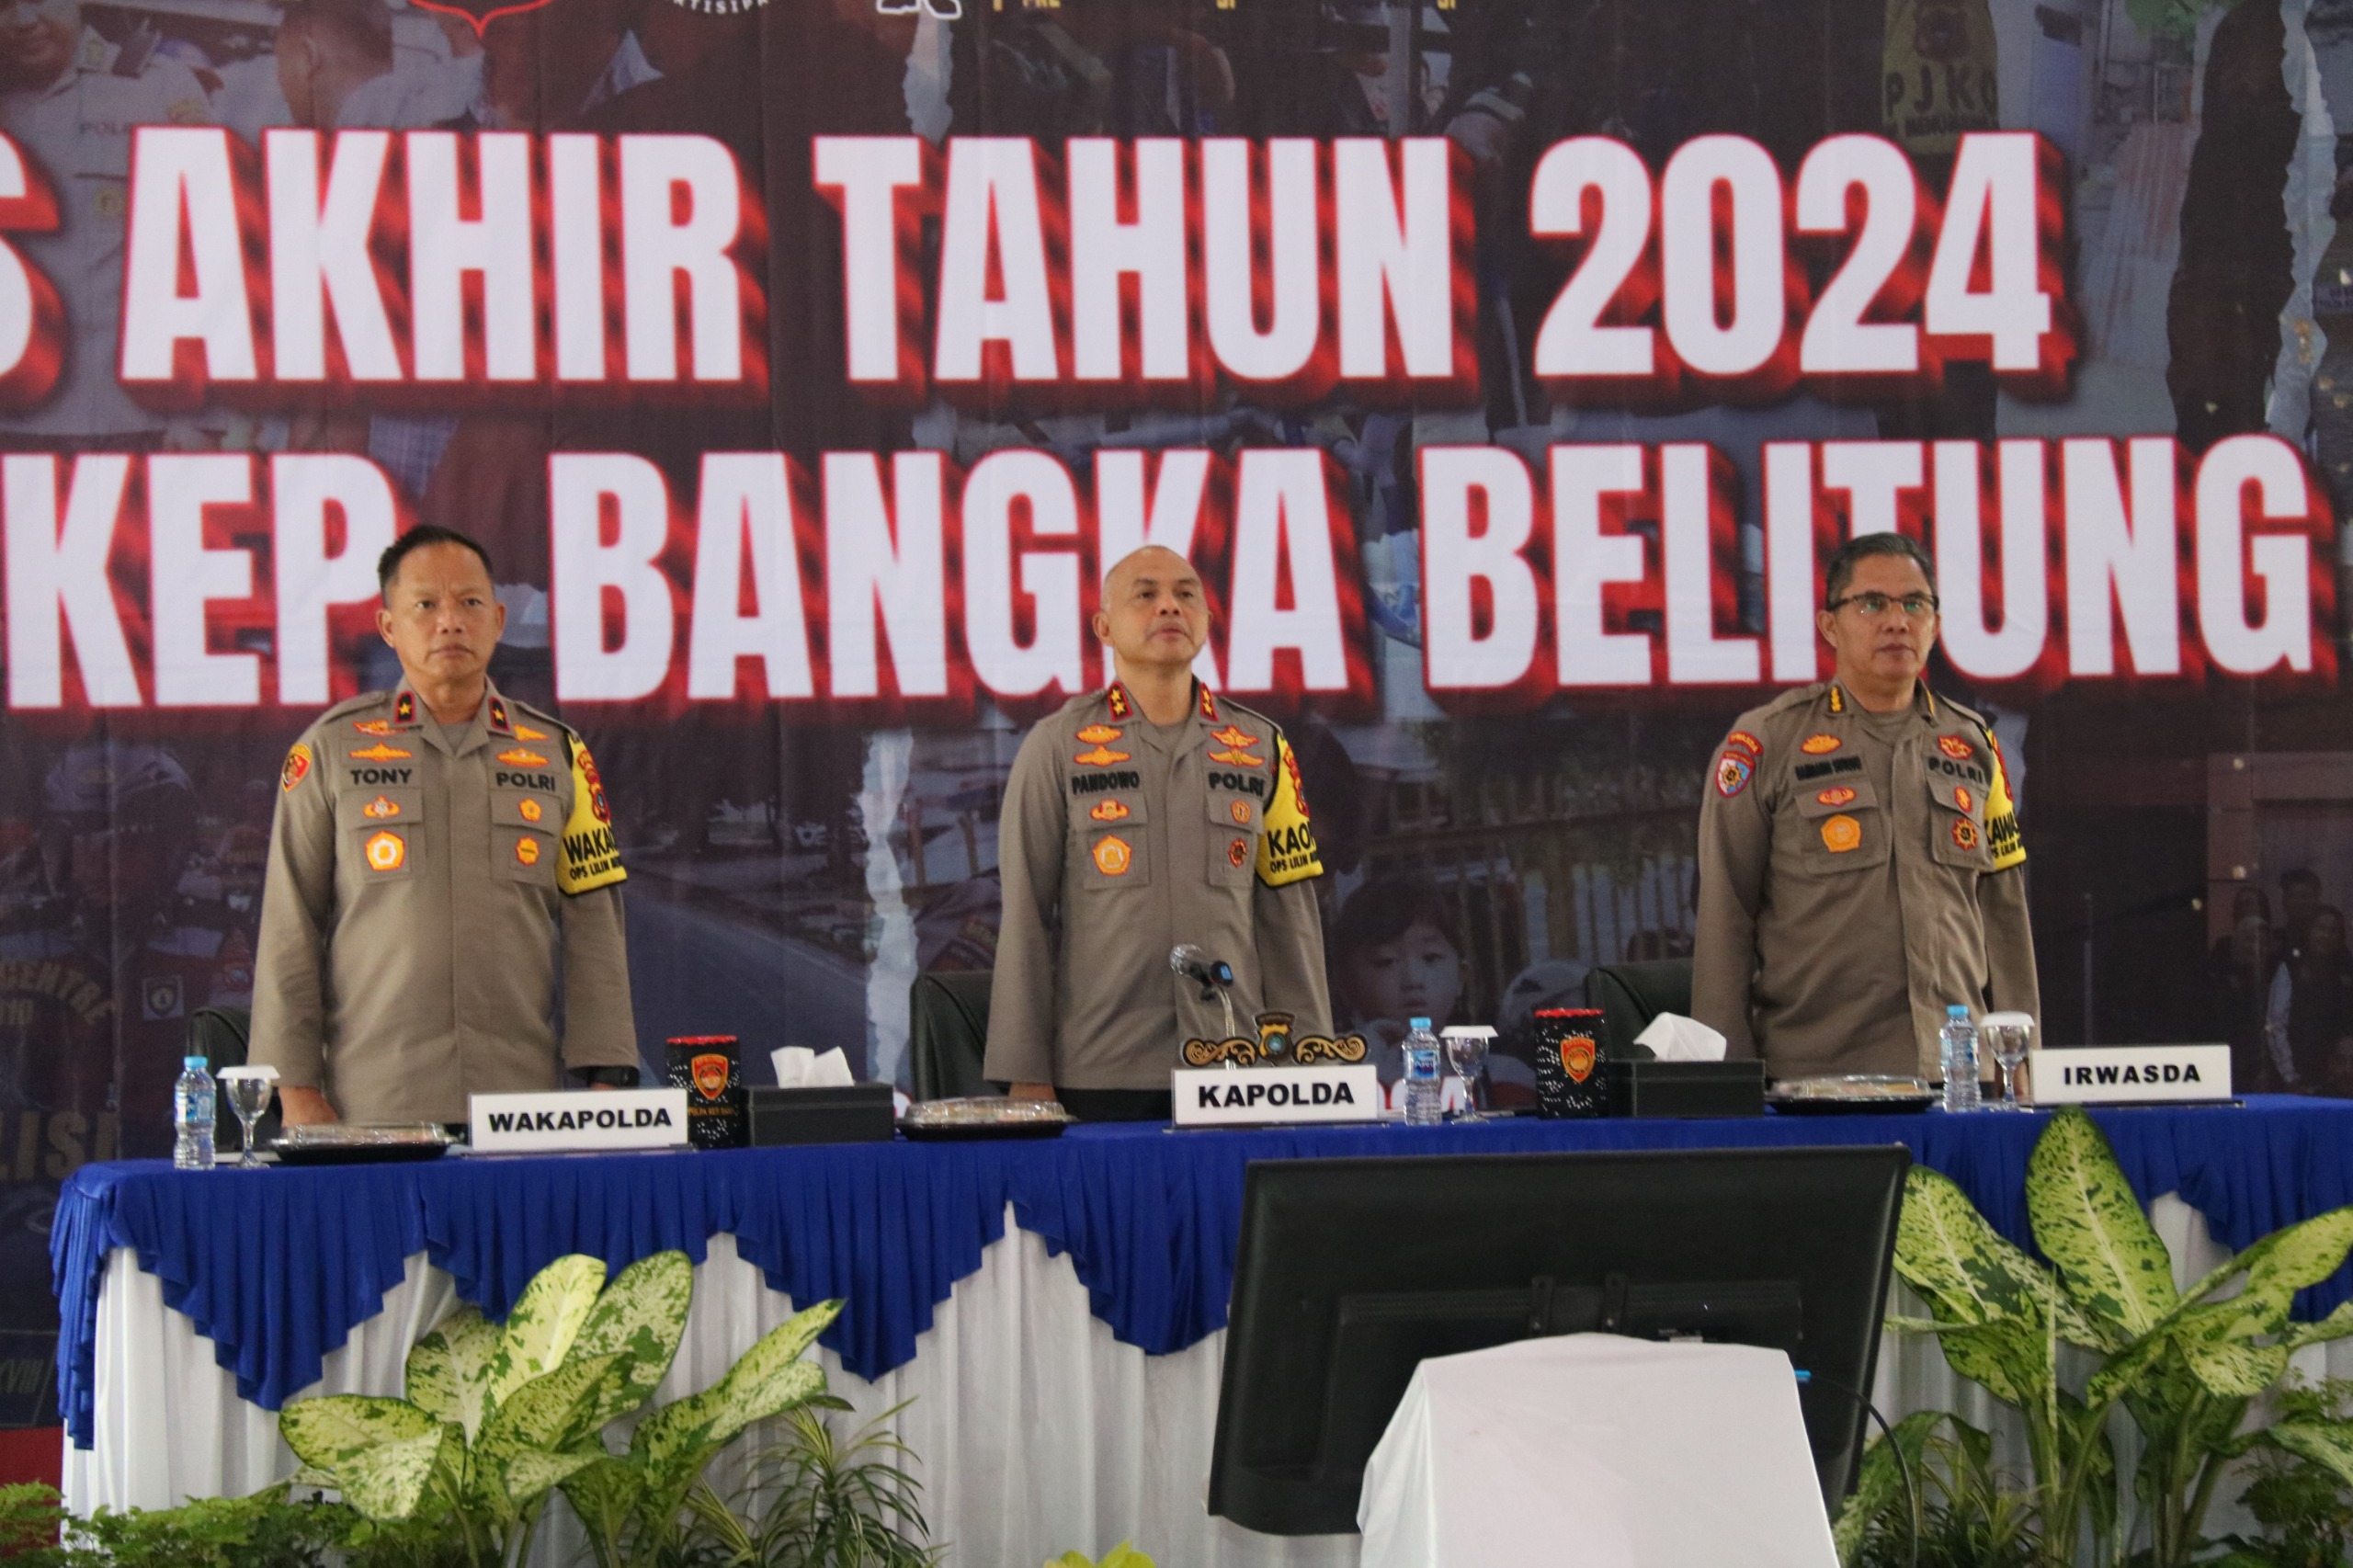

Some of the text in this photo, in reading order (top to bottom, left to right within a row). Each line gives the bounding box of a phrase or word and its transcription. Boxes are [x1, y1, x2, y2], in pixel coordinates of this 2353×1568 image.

[120, 127, 743, 382] AKHIR
[813, 135, 1454, 382] TAHUN
[1529, 133, 2052, 379] 2024
[2, 436, 2313, 709] KEP BANGKA BELITUNG
[350, 768, 412, 785] TONY
[495, 772, 555, 792] POLRI
[1928, 756, 1983, 784] POLRI
[1209, 772, 1265, 797] POLRI
[570, 865, 587, 881] OPS
[1269, 859, 1287, 873] OPS
[2064, 1063, 2200, 1085] IRWASDA
[1198, 1082, 1355, 1108] KAPOLDA
[488, 1108, 672, 1132] WAKAPOLDA
